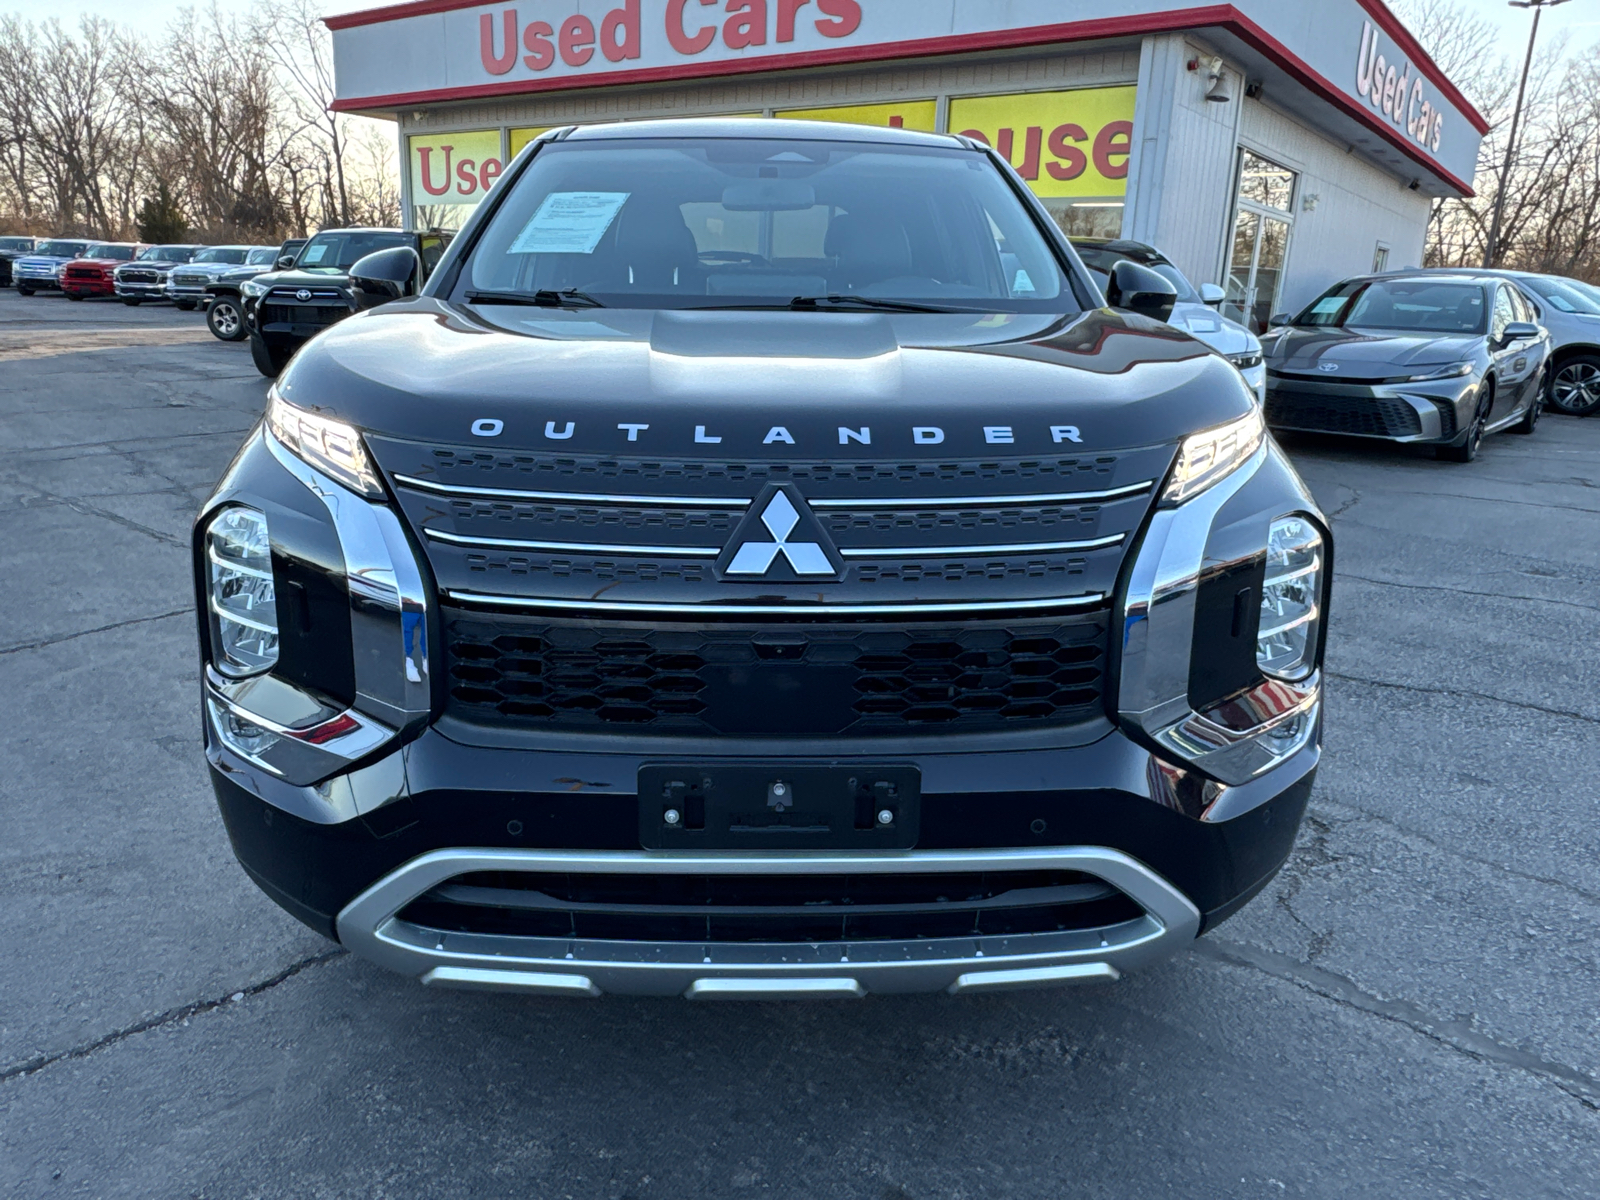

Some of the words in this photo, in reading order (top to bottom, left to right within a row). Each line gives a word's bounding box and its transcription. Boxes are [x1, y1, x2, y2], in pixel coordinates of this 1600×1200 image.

[480, 0, 642, 76] Used
[665, 0, 862, 55] Cars
[1356, 20, 1411, 125] Used
[1406, 77, 1443, 153] Cars
[416, 145, 502, 196] Use
[957, 120, 1135, 182] use
[470, 418, 1084, 446] OUTLANDER
